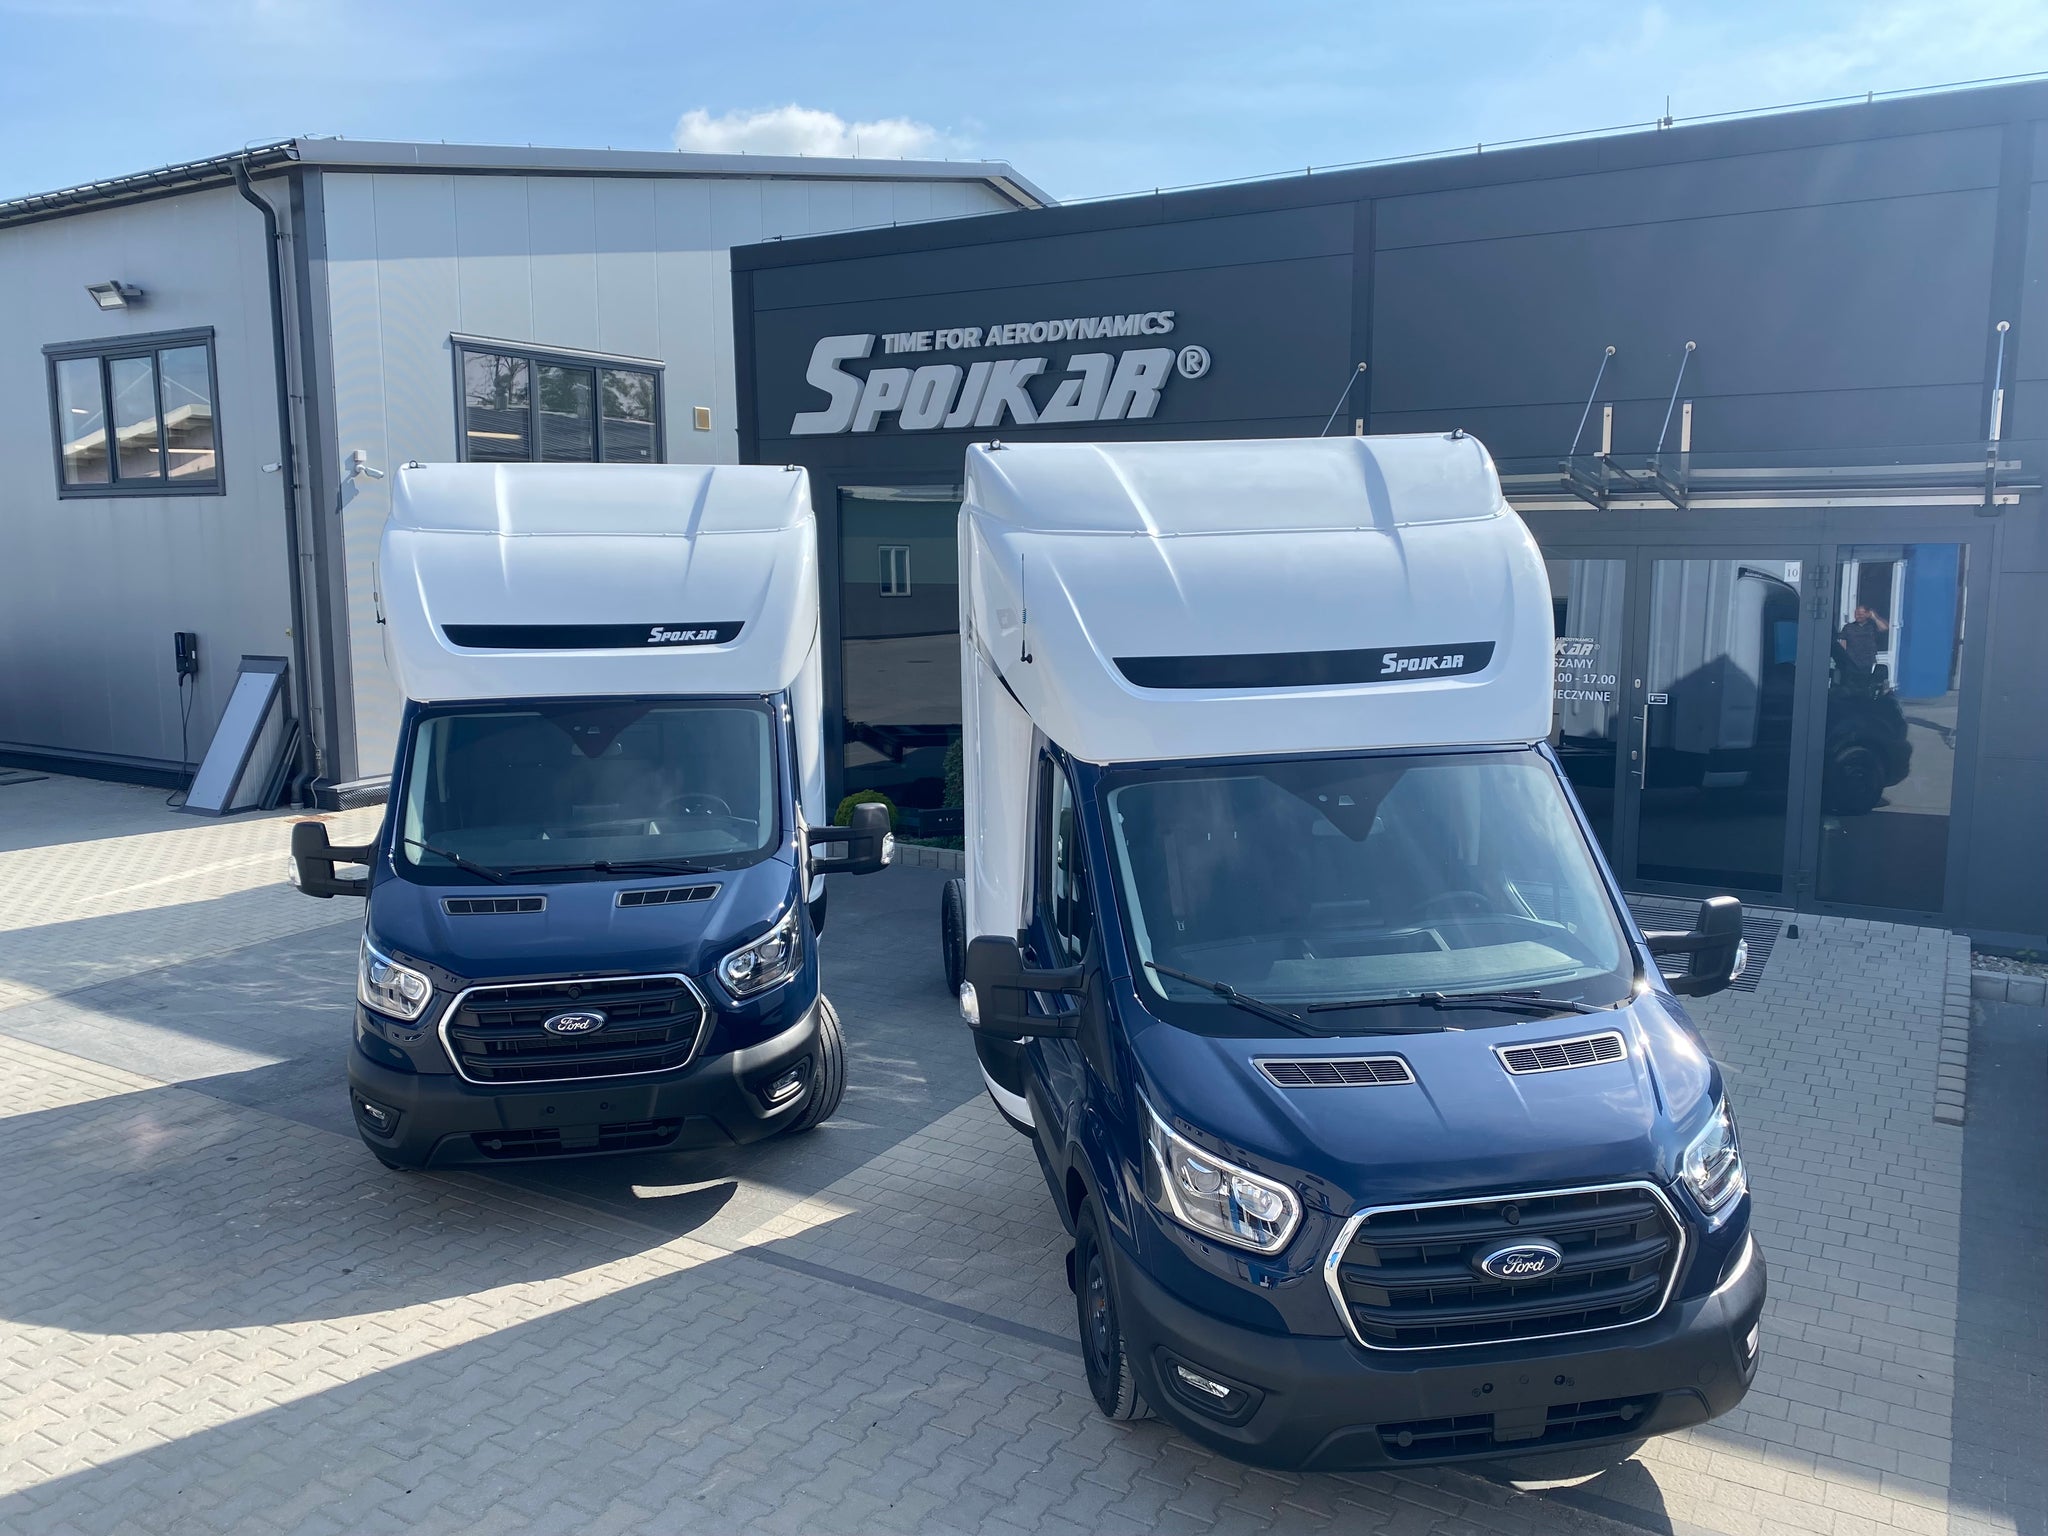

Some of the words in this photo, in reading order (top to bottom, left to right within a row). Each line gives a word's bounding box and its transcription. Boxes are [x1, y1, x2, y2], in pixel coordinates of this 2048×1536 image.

[882, 330, 933, 354] TIME
[935, 326, 982, 350] FOR
[985, 310, 1175, 347] AERODYNAMICS
[1787, 569, 1798, 577] 10
[647, 626, 718, 643] SPOJKAR
[1380, 652, 1464, 674] SPOJKAR
[1583, 673, 1616, 685] 17.00
[557, 1016, 590, 1031] Ford
[1502, 1252, 1546, 1275] Ford
